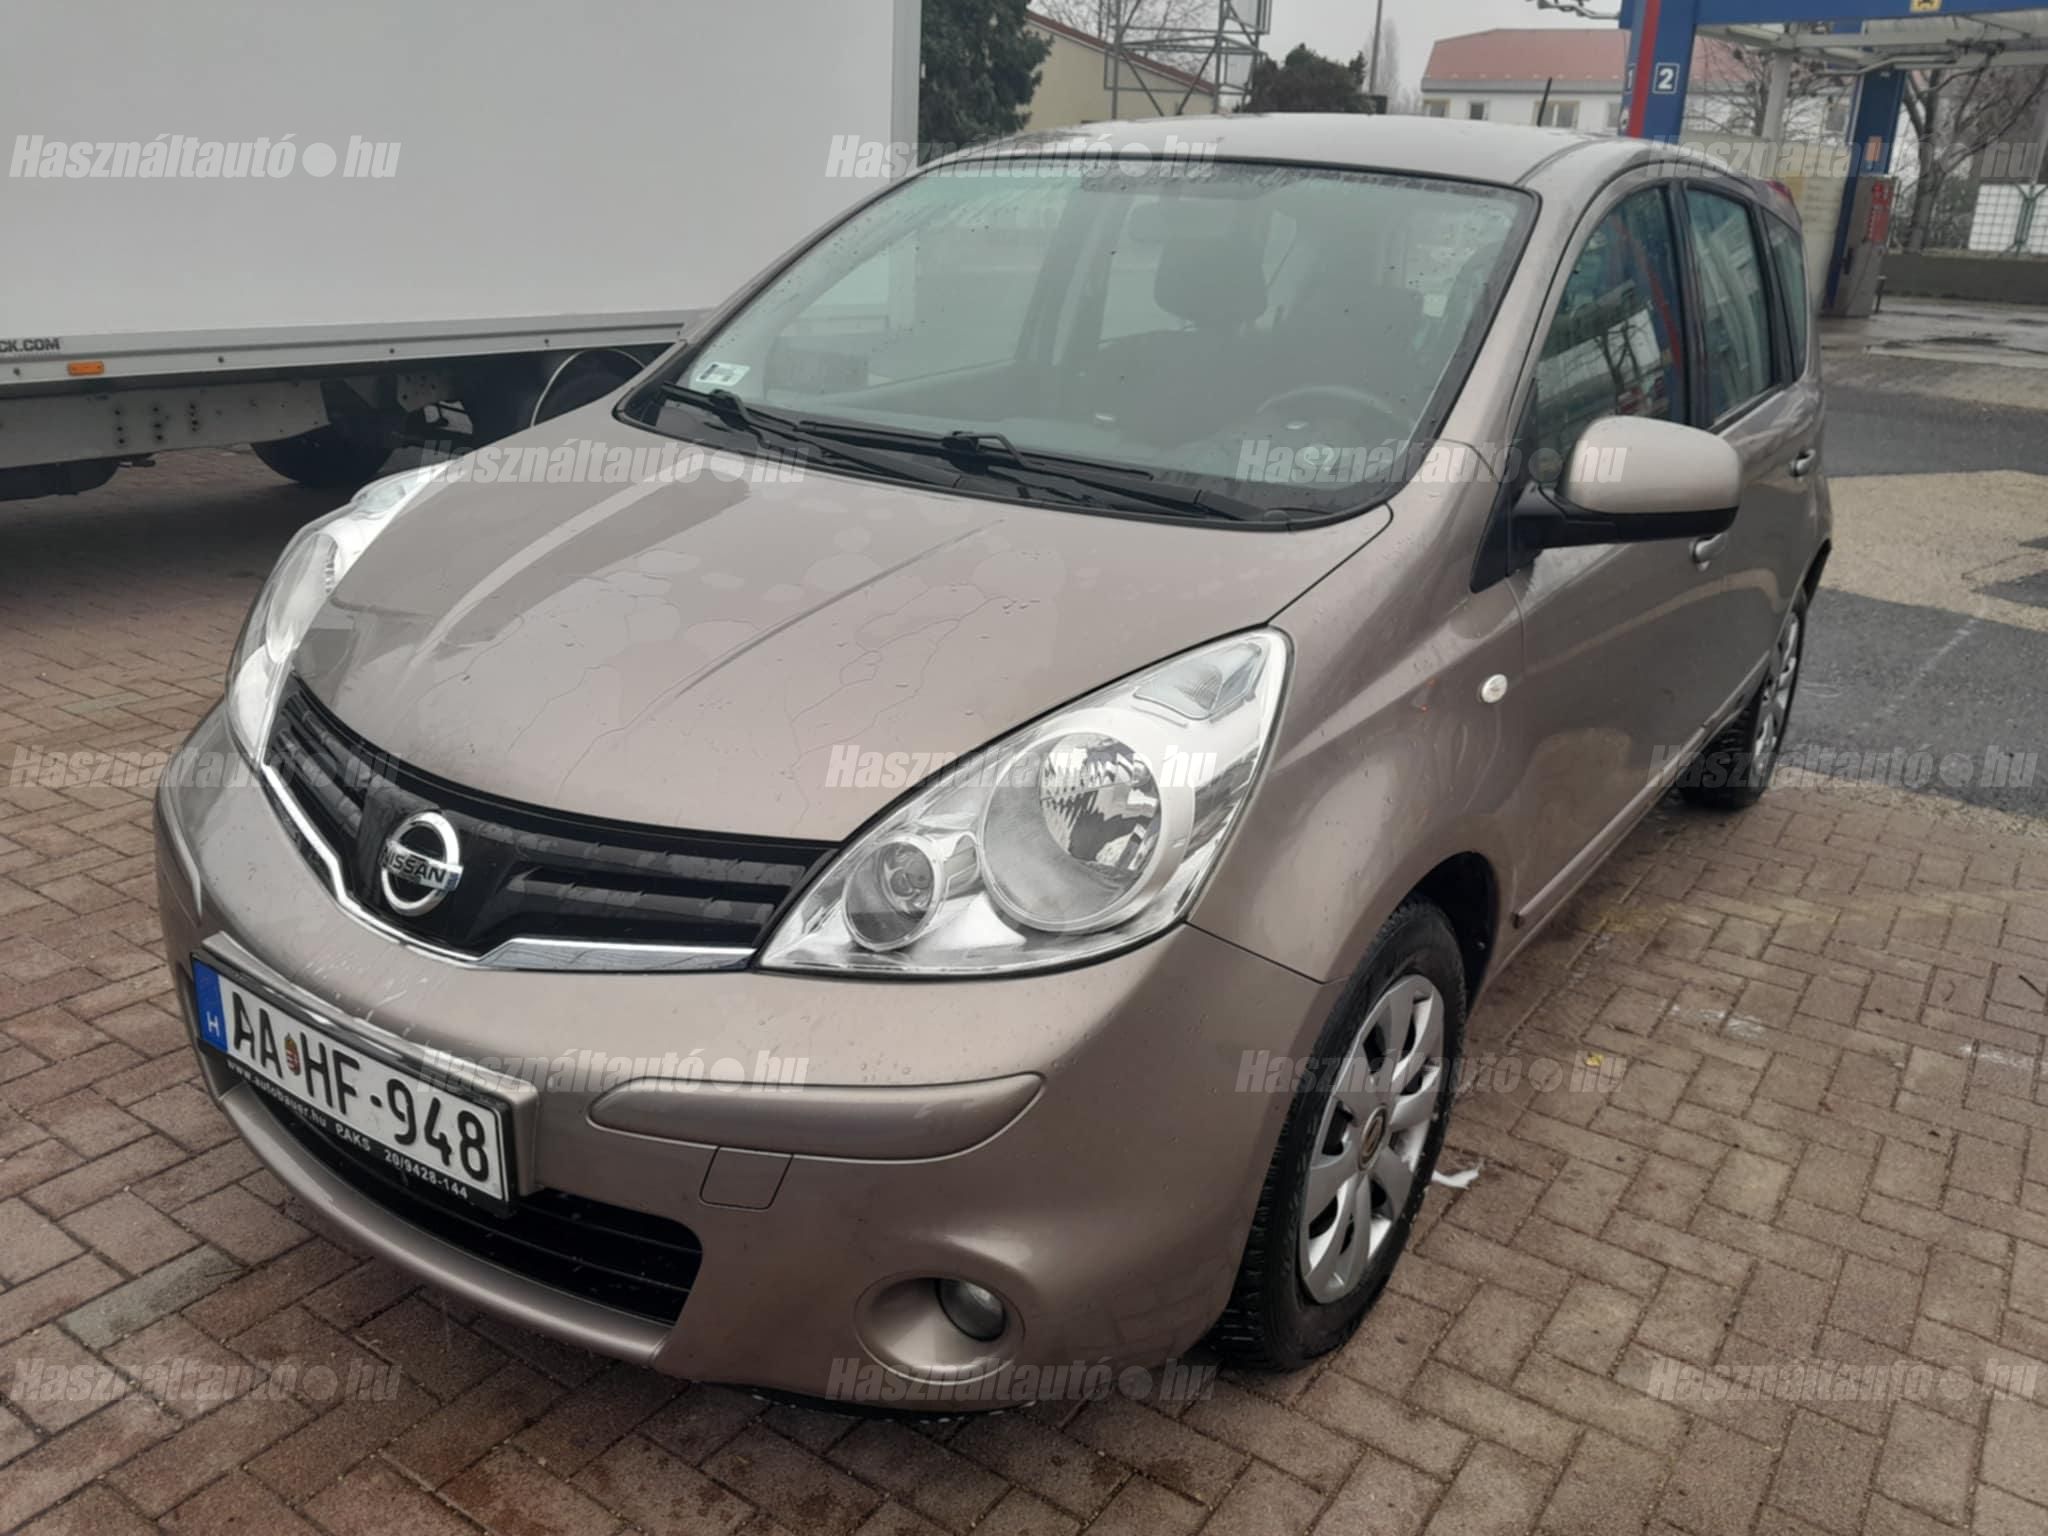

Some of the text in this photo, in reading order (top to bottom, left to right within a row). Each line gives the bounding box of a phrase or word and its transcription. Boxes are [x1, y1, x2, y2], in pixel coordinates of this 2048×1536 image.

[1657, 67, 1675, 90] 2
[382, 844, 448, 884] NISSAN
[206, 1010, 219, 1037] H
[335, 1123, 372, 1152] PAKS
